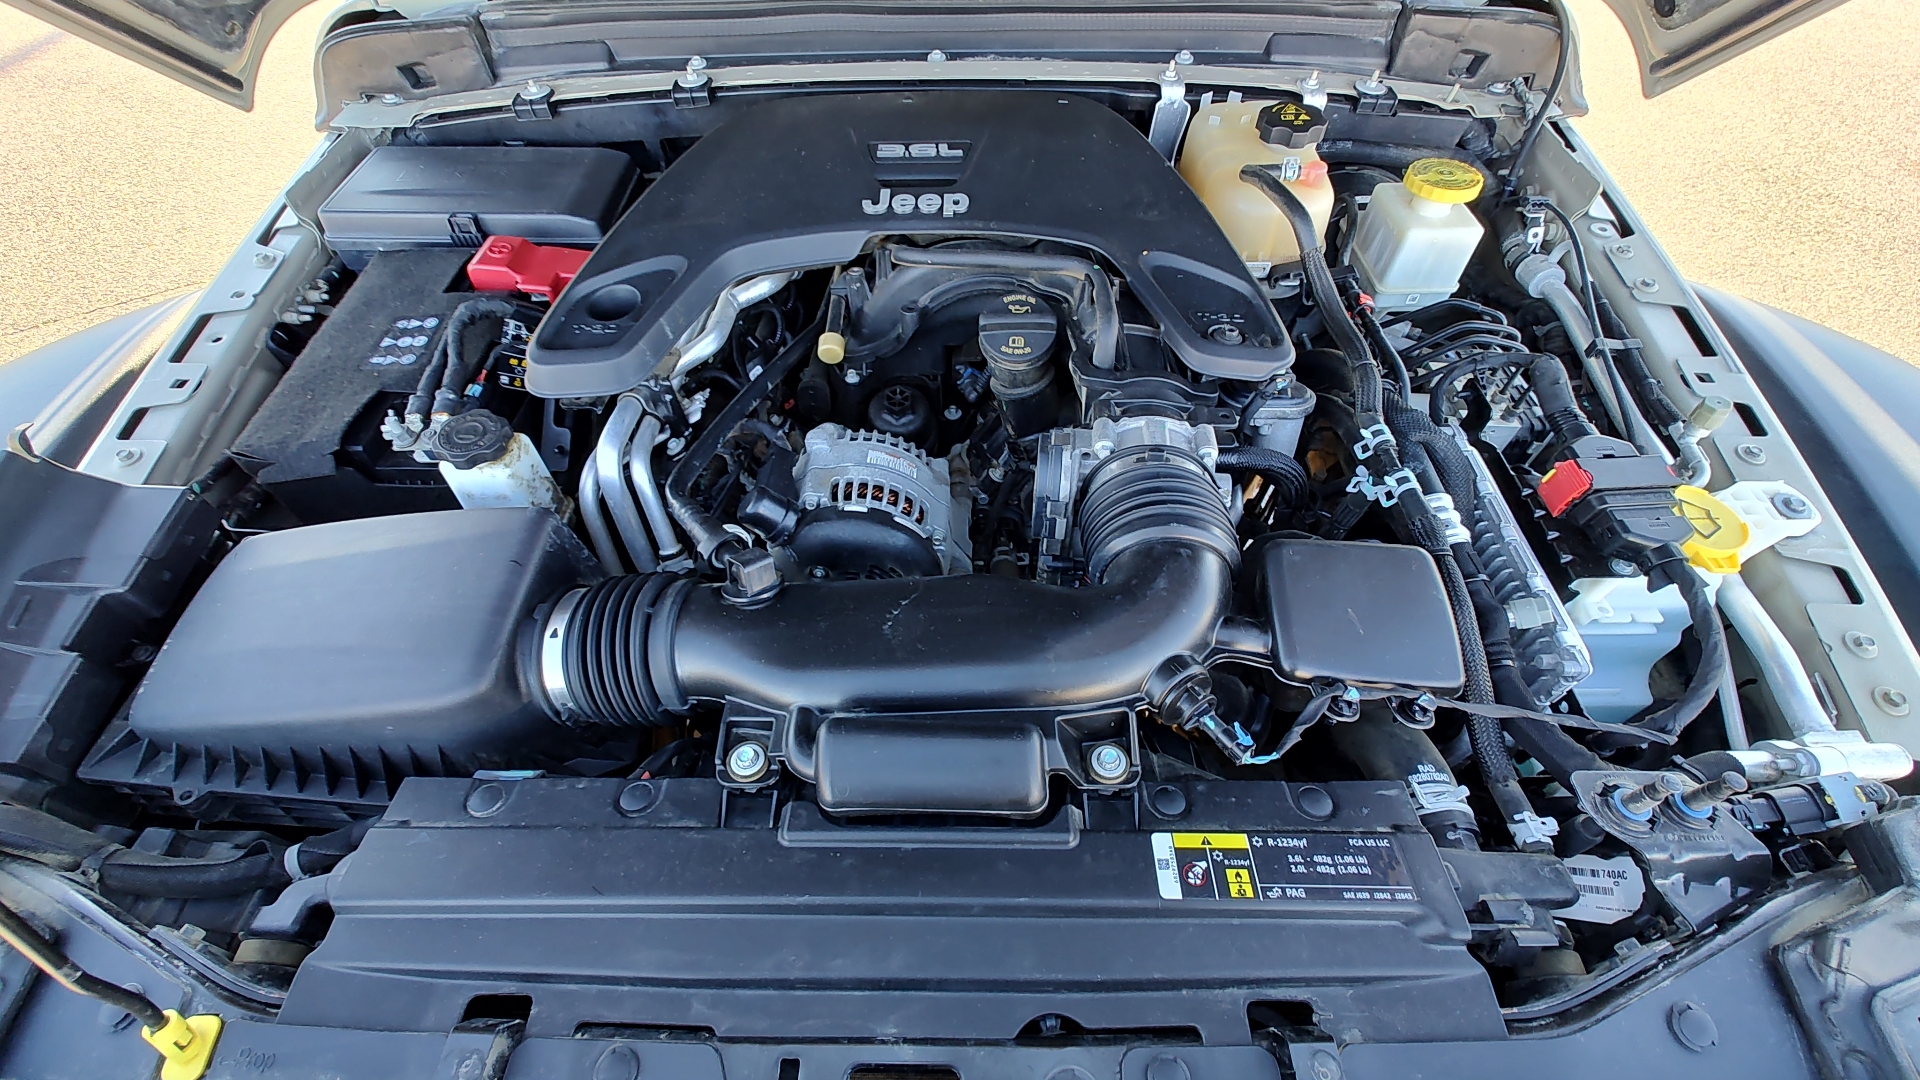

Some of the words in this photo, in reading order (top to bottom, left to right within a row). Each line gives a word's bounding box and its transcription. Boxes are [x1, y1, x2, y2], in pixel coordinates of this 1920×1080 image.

[876, 143, 964, 158] 3.6L
[861, 188, 970, 218] Jeep
[1003, 294, 1027, 304] ENGINE
[1027, 295, 1037, 305] OIL
[1000, 345, 1013, 354] SAE
[1014, 346, 1032, 355] 0W-20
[1417, 764, 1436, 773] RAD
[1266, 838, 1308, 849] R-1234yf
[1349, 838, 1364, 847] FCA
[1364, 838, 1375, 847] US
[1376, 838, 1391, 847] LLC
[1287, 854, 1304, 863] 3.6L
[1312, 854, 1333, 865] 482g
[1290, 864, 1308, 873] 2.0L
[1316, 864, 1336, 875] 482g
[1285, 888, 1307, 898] PAG
[1342, 891, 1356, 900] SAE
[234, 1046, 276, 1074] Prop
